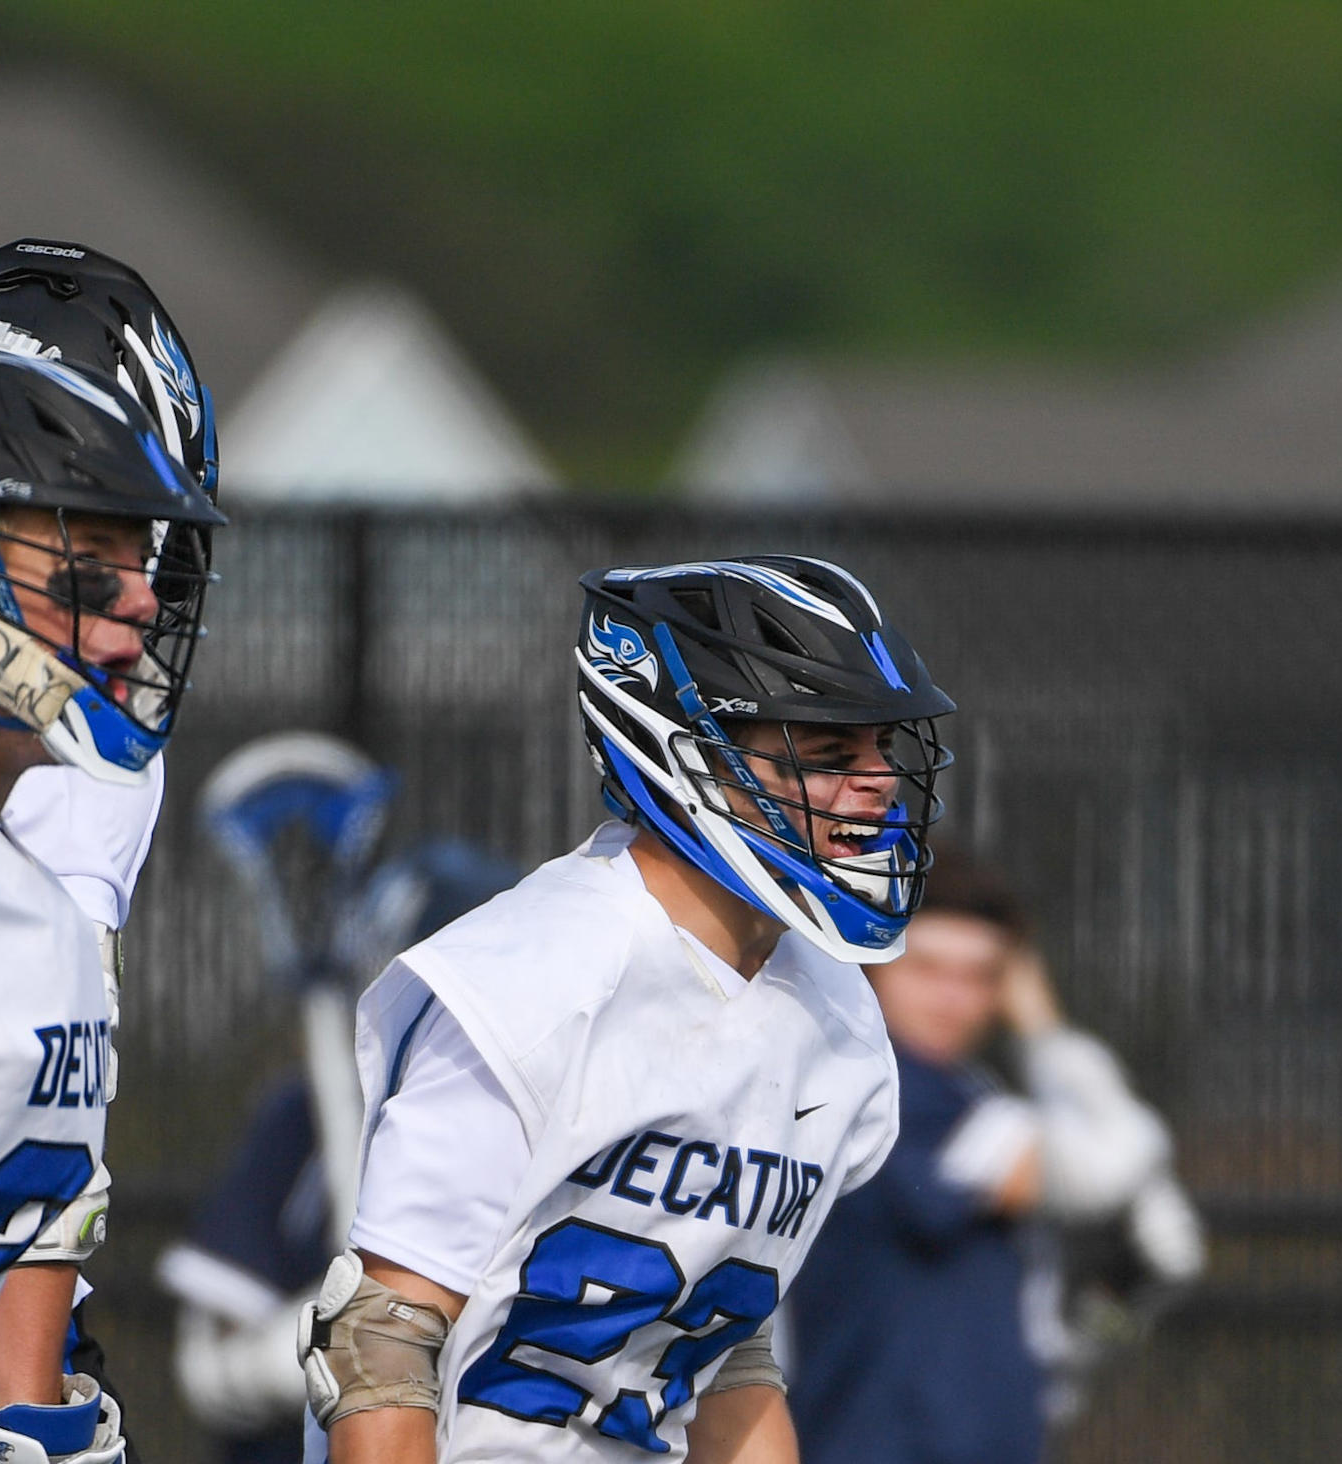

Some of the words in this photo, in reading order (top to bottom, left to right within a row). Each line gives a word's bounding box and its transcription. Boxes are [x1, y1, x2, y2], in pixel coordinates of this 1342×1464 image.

[16, 243, 86, 260] cascade
[565, 1129, 825, 1241] DECATUR
[457, 1215, 779, 1454] 23
